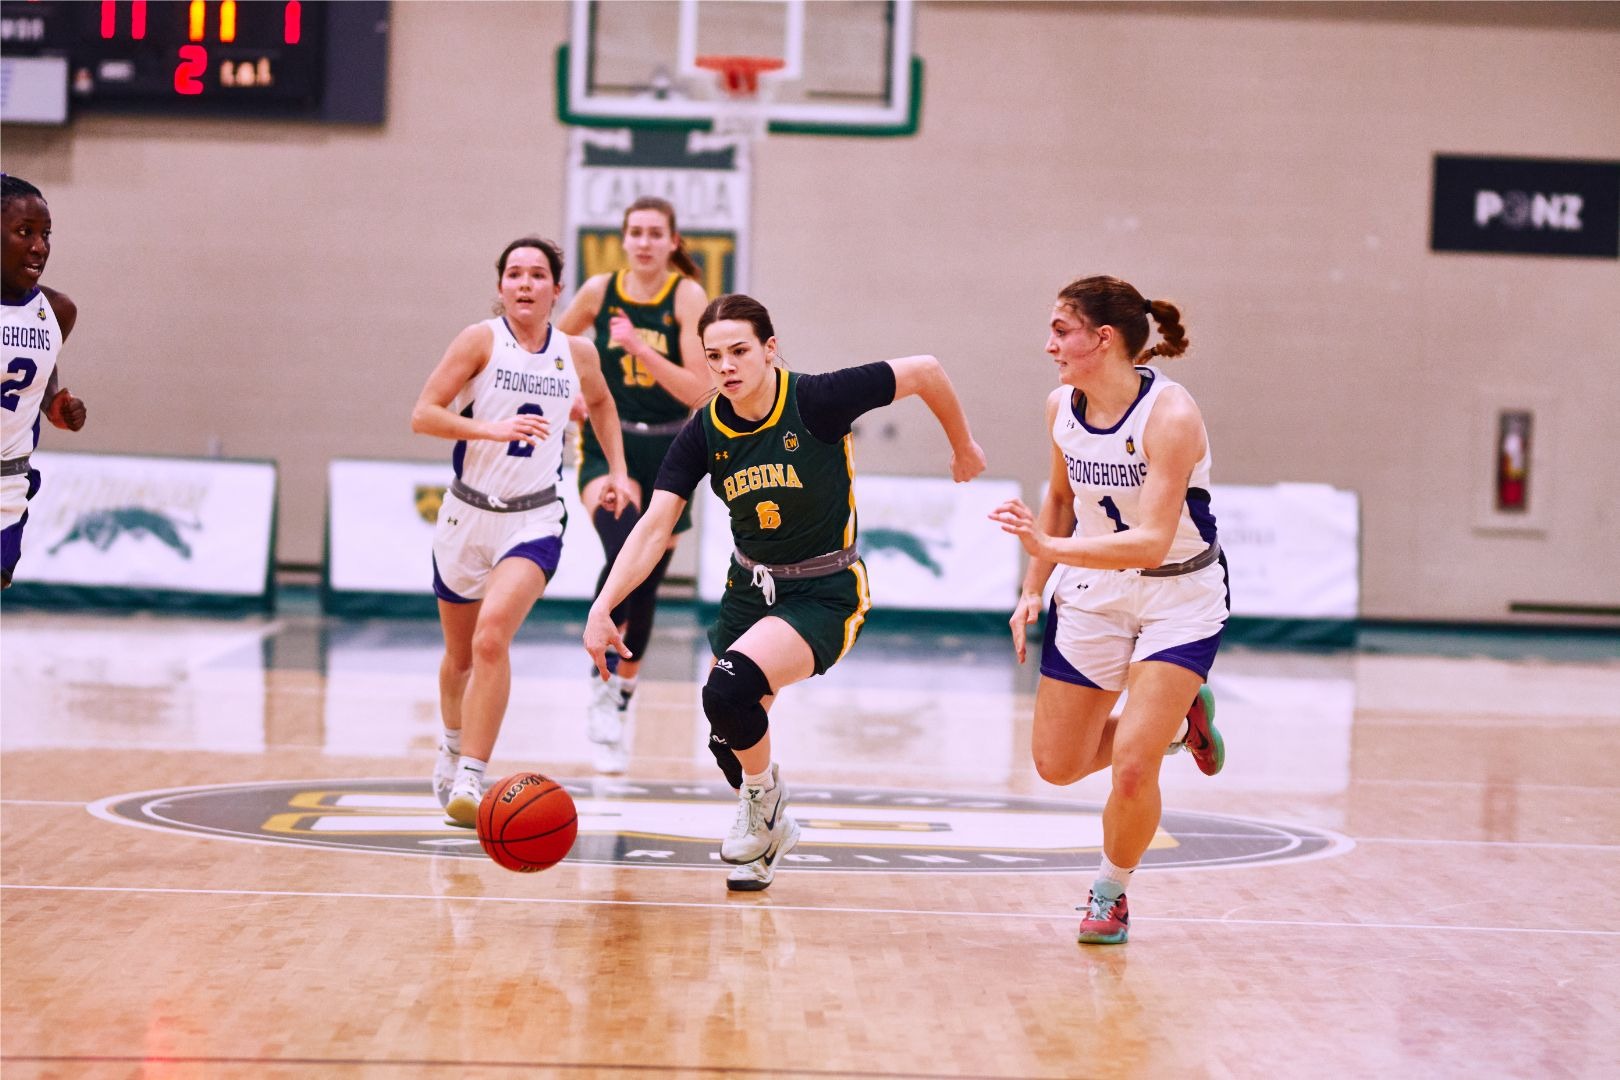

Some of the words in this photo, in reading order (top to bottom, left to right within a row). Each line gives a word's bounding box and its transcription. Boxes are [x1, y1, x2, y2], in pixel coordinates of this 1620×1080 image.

[174, 44, 207, 94] 2
[0, 326, 51, 351] GHORNS
[0, 356, 38, 412] 2
[494, 368, 570, 399] PRONGHORNS
[723, 463, 803, 502] REGINA
[755, 500, 782, 530] 6
[1097, 495, 1130, 533] 1
